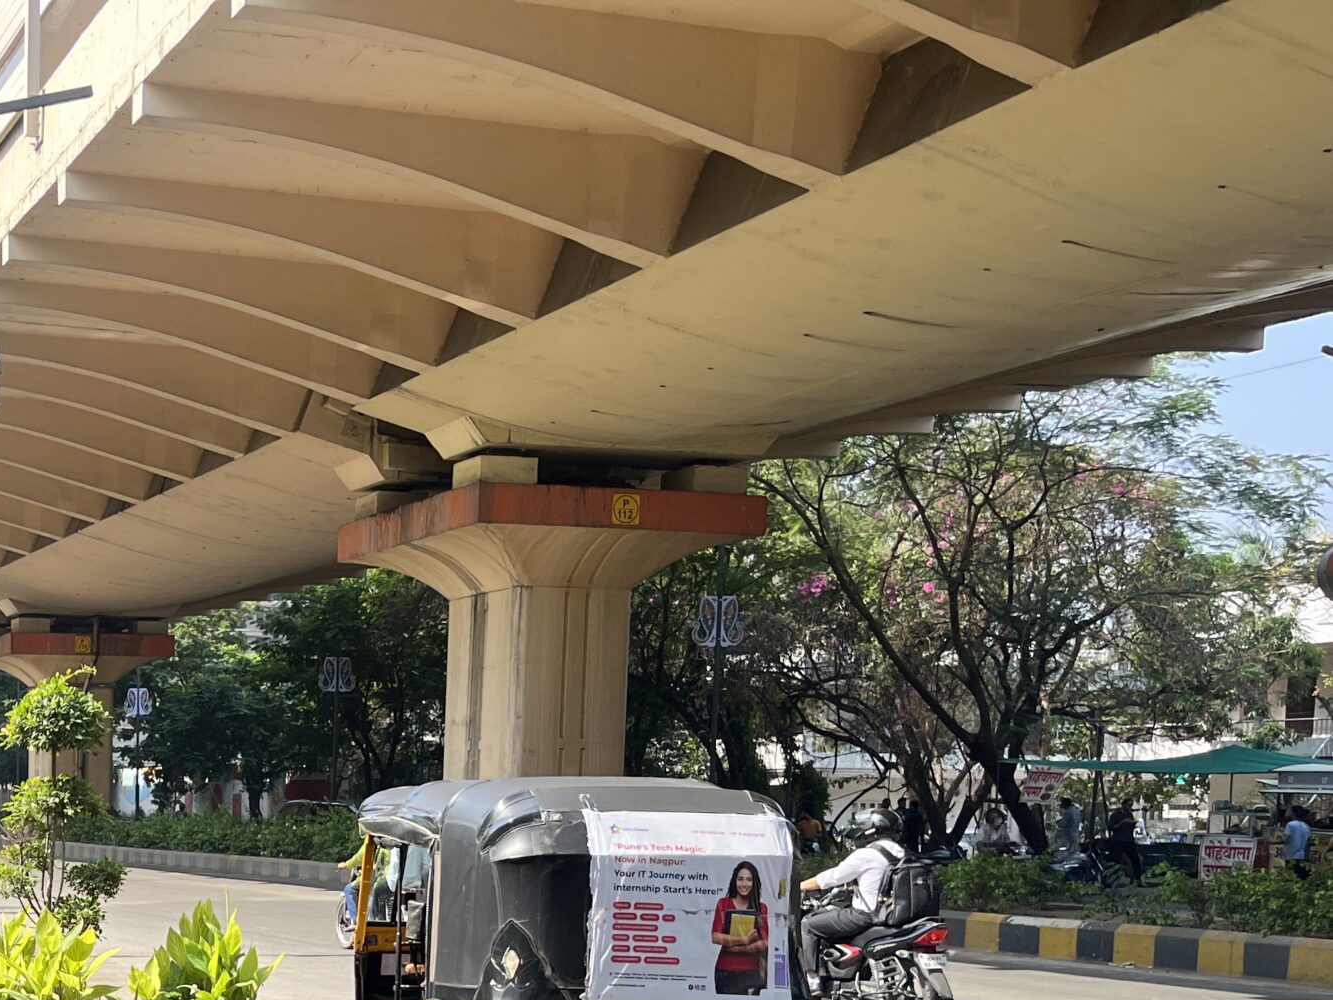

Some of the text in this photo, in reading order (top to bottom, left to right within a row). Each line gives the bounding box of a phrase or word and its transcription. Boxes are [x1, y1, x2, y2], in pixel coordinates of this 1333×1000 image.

[623, 499, 629, 508] P
[617, 510, 633, 519] 112
[650, 843, 673, 852] Tech
[614, 855, 687, 867] Now in Nagpur:
[614, 869, 709, 882] Your IT Journey with
[613, 883, 662, 895] internship
[663, 885, 693, 895] Start's
